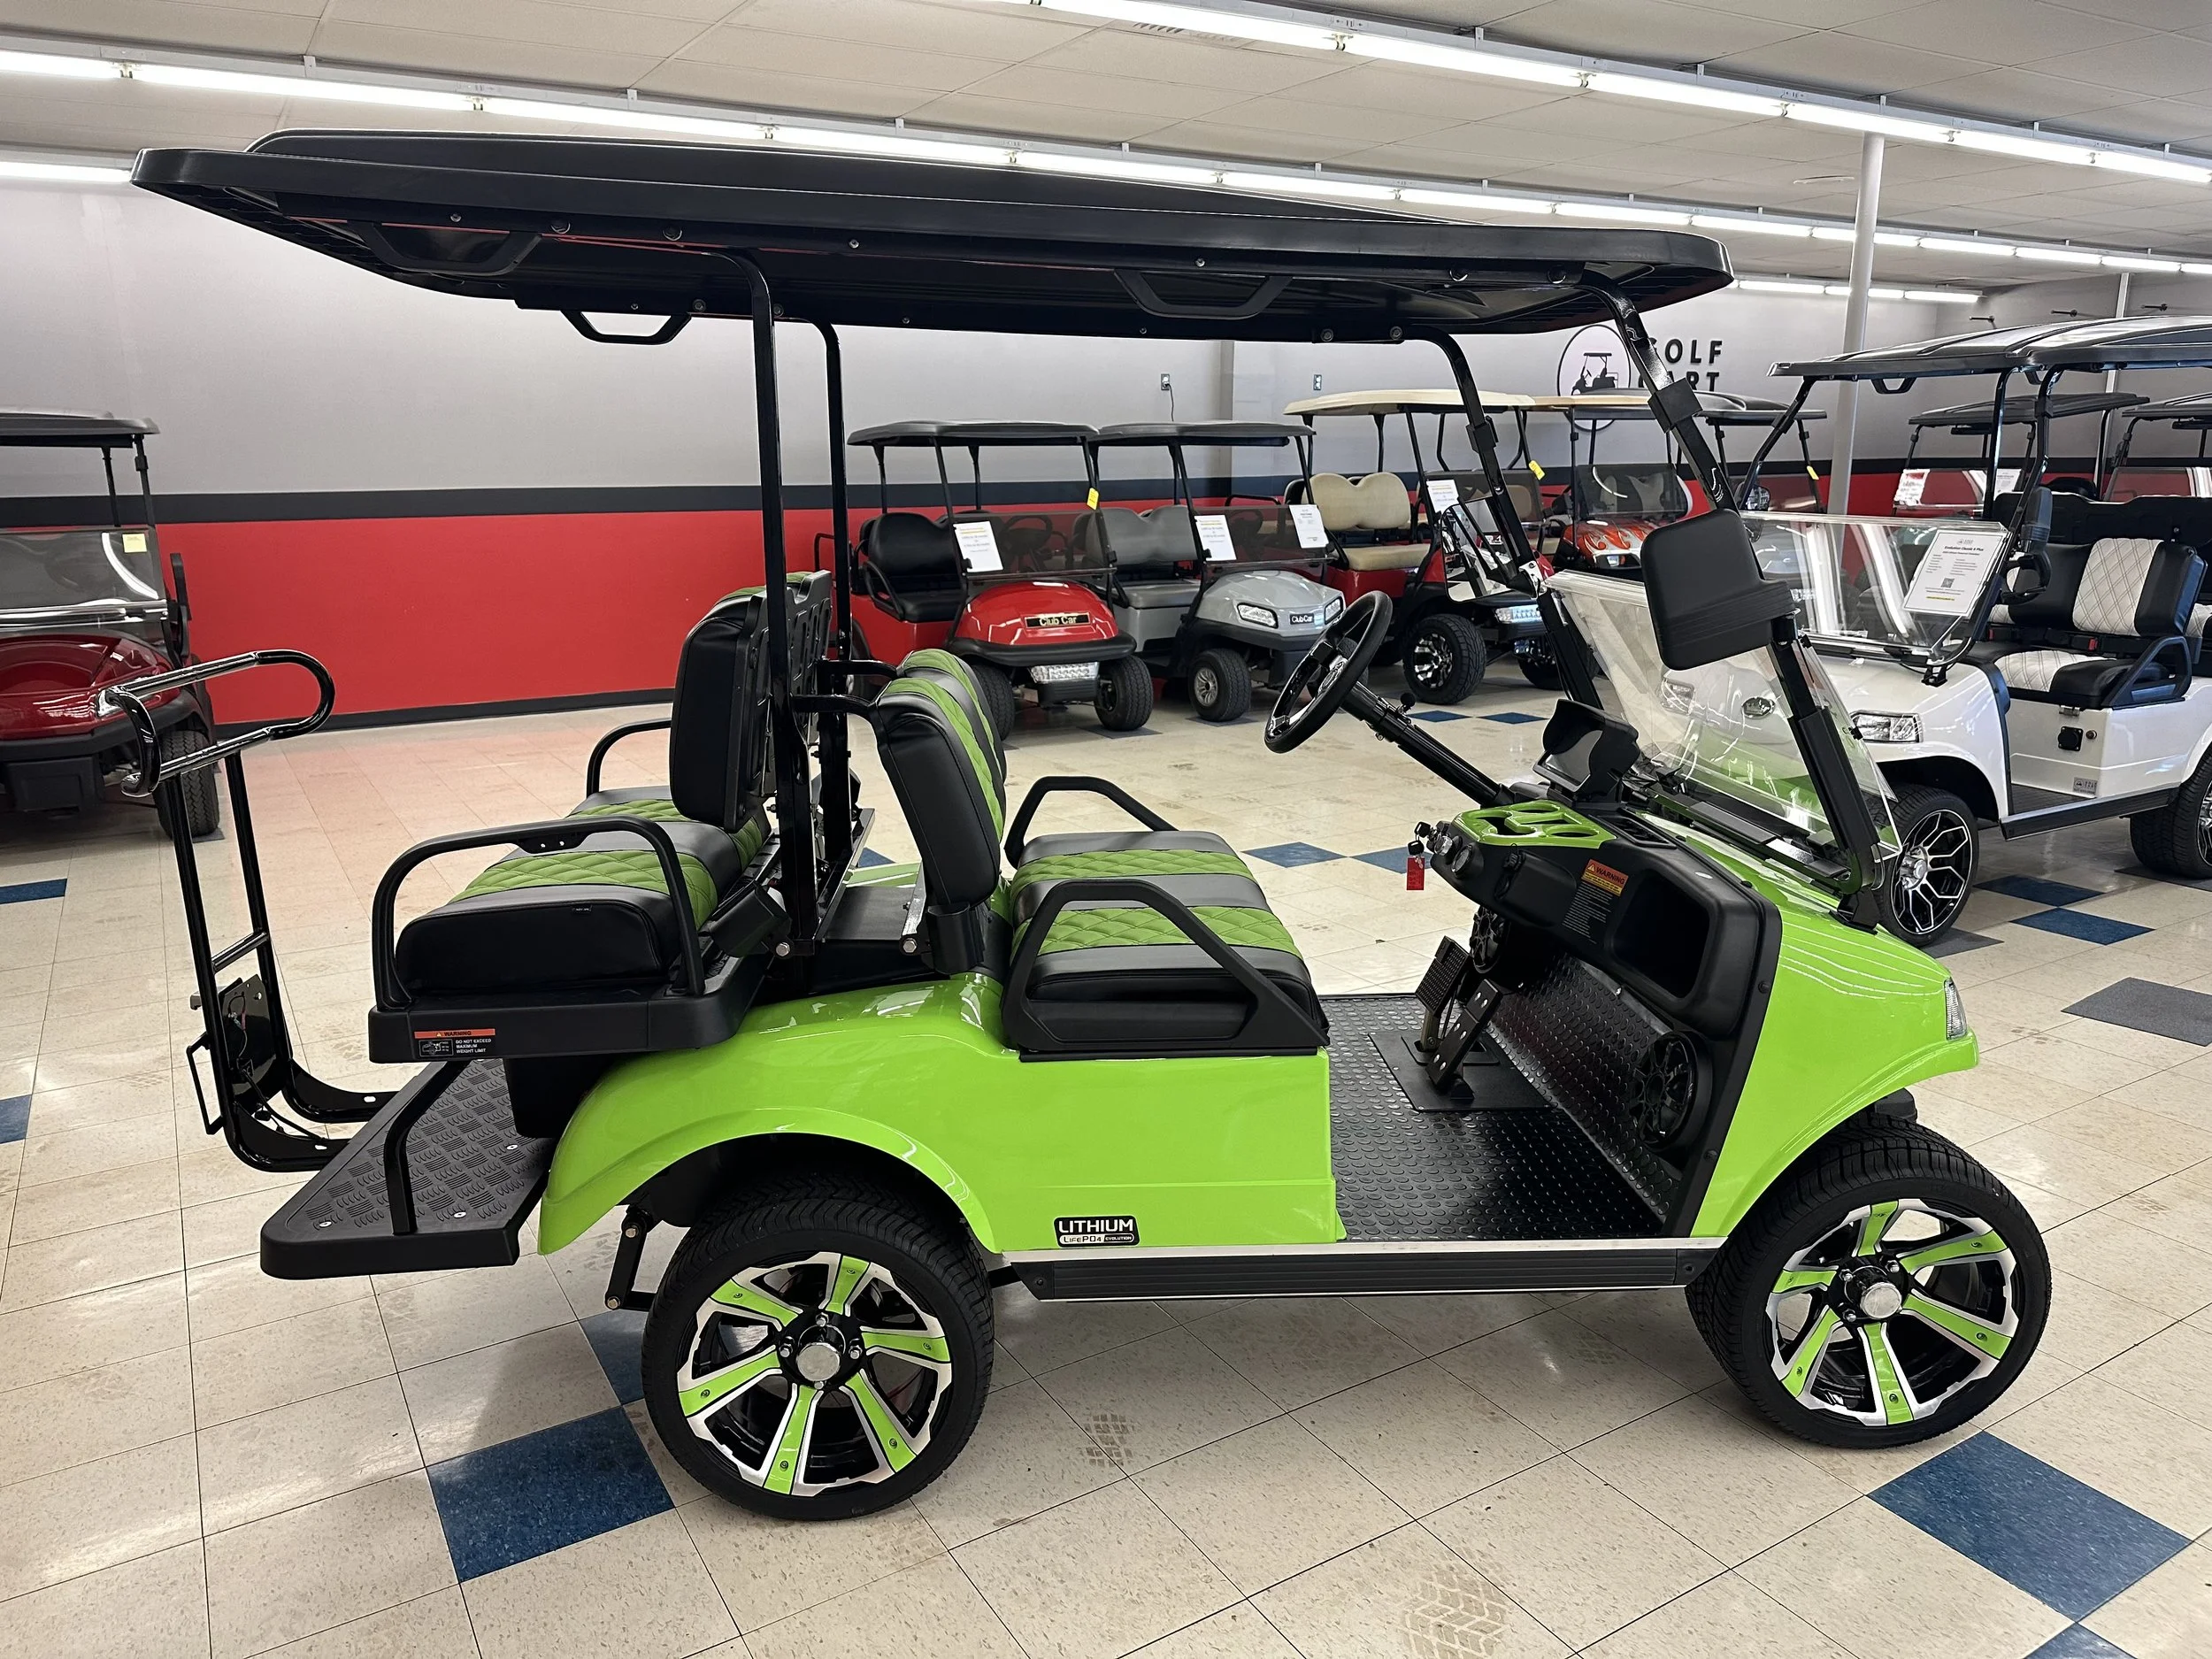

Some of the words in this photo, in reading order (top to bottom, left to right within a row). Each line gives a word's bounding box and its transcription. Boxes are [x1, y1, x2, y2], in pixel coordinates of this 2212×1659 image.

[1648, 337, 1723, 364] OLF
[1039, 617, 1060, 626] Club
[1061, 616, 1077, 625] Car
[1596, 867, 1625, 885] WARNING
[1058, 1218, 1133, 1233] LITHIUM
